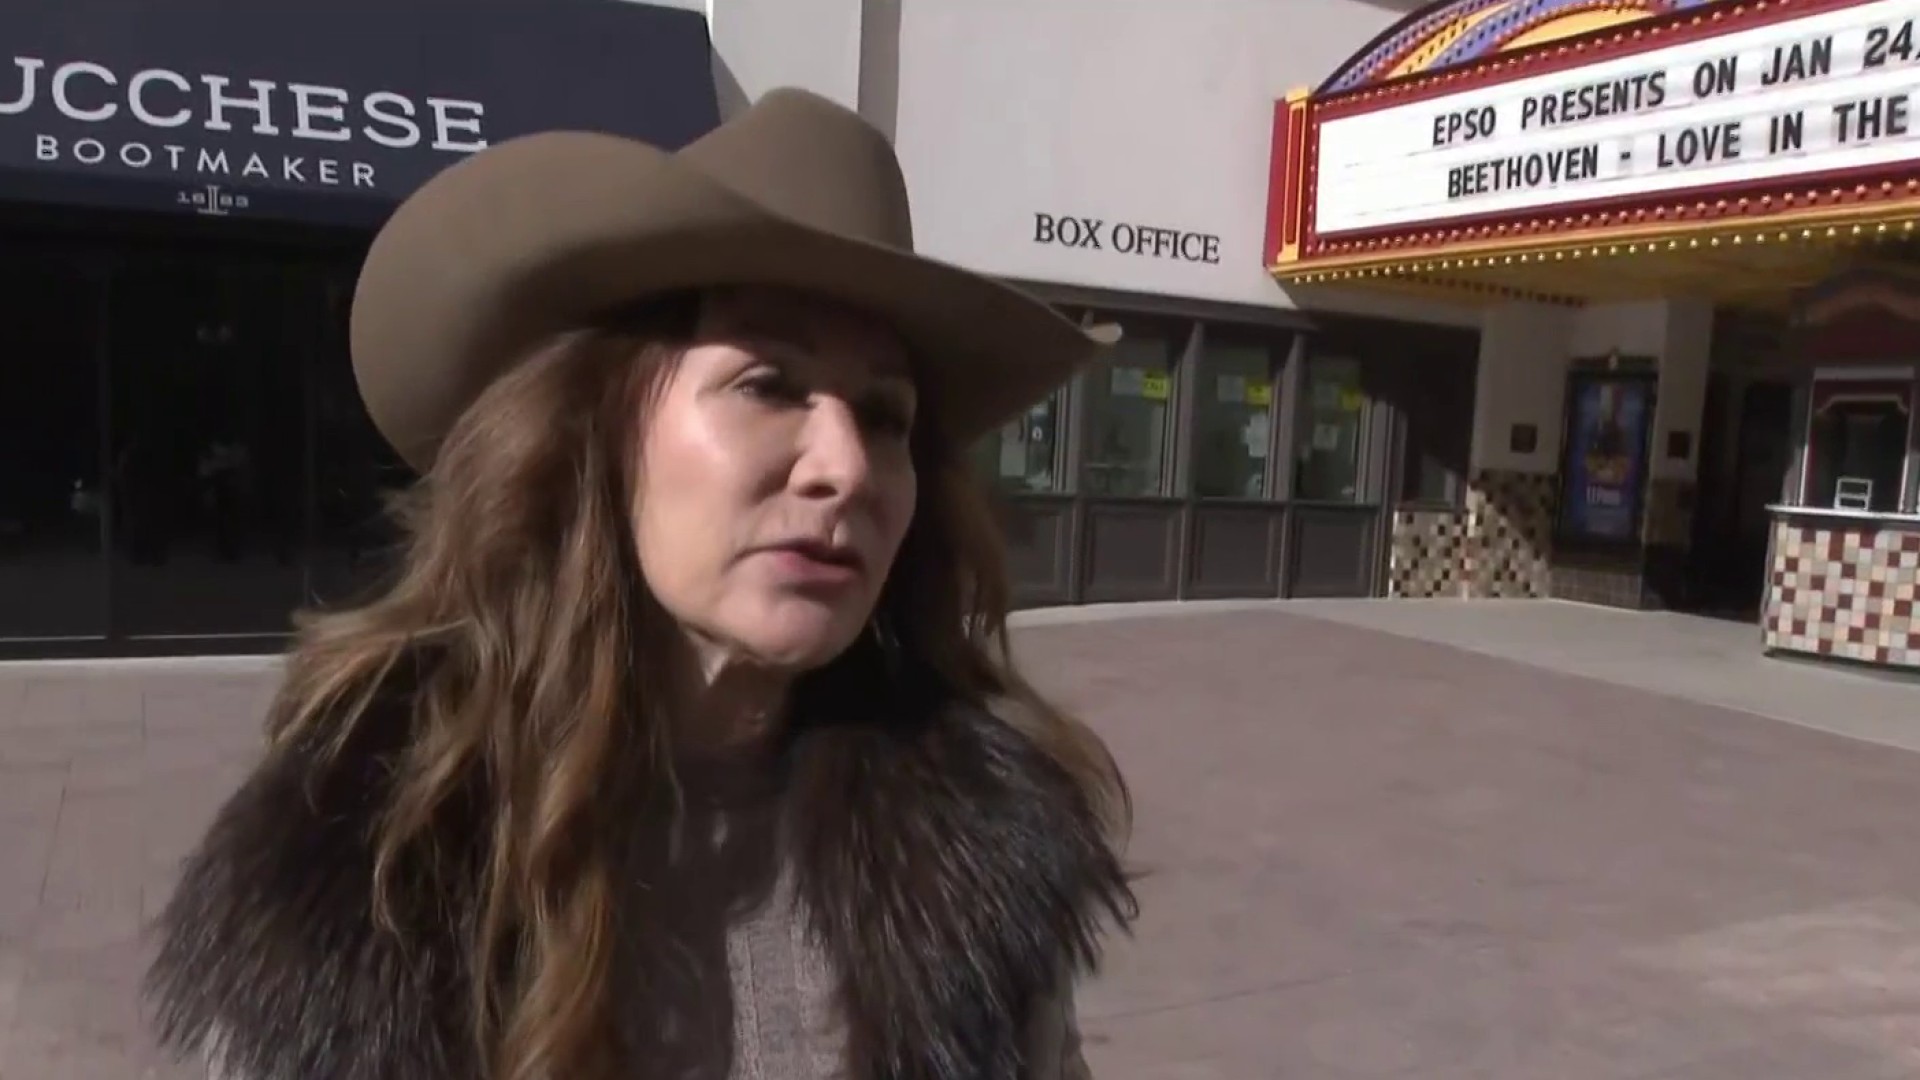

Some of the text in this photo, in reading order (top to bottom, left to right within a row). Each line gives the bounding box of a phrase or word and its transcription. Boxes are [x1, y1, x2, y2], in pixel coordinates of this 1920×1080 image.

[1433, 107, 1496, 146] EPSO
[1521, 71, 1667, 130] PRESENTS
[1693, 56, 1738, 97] ON
[1761, 36, 1832, 86] JAN
[36, 134, 375, 187] BOOTMAKER
[1447, 144, 1599, 199] BEETHOVEN
[1657, 122, 1741, 168] LOVE
[1770, 112, 1804, 154] IN
[1833, 94, 1909, 143] THE
[1034, 212, 1220, 264] BOX OFFICE
